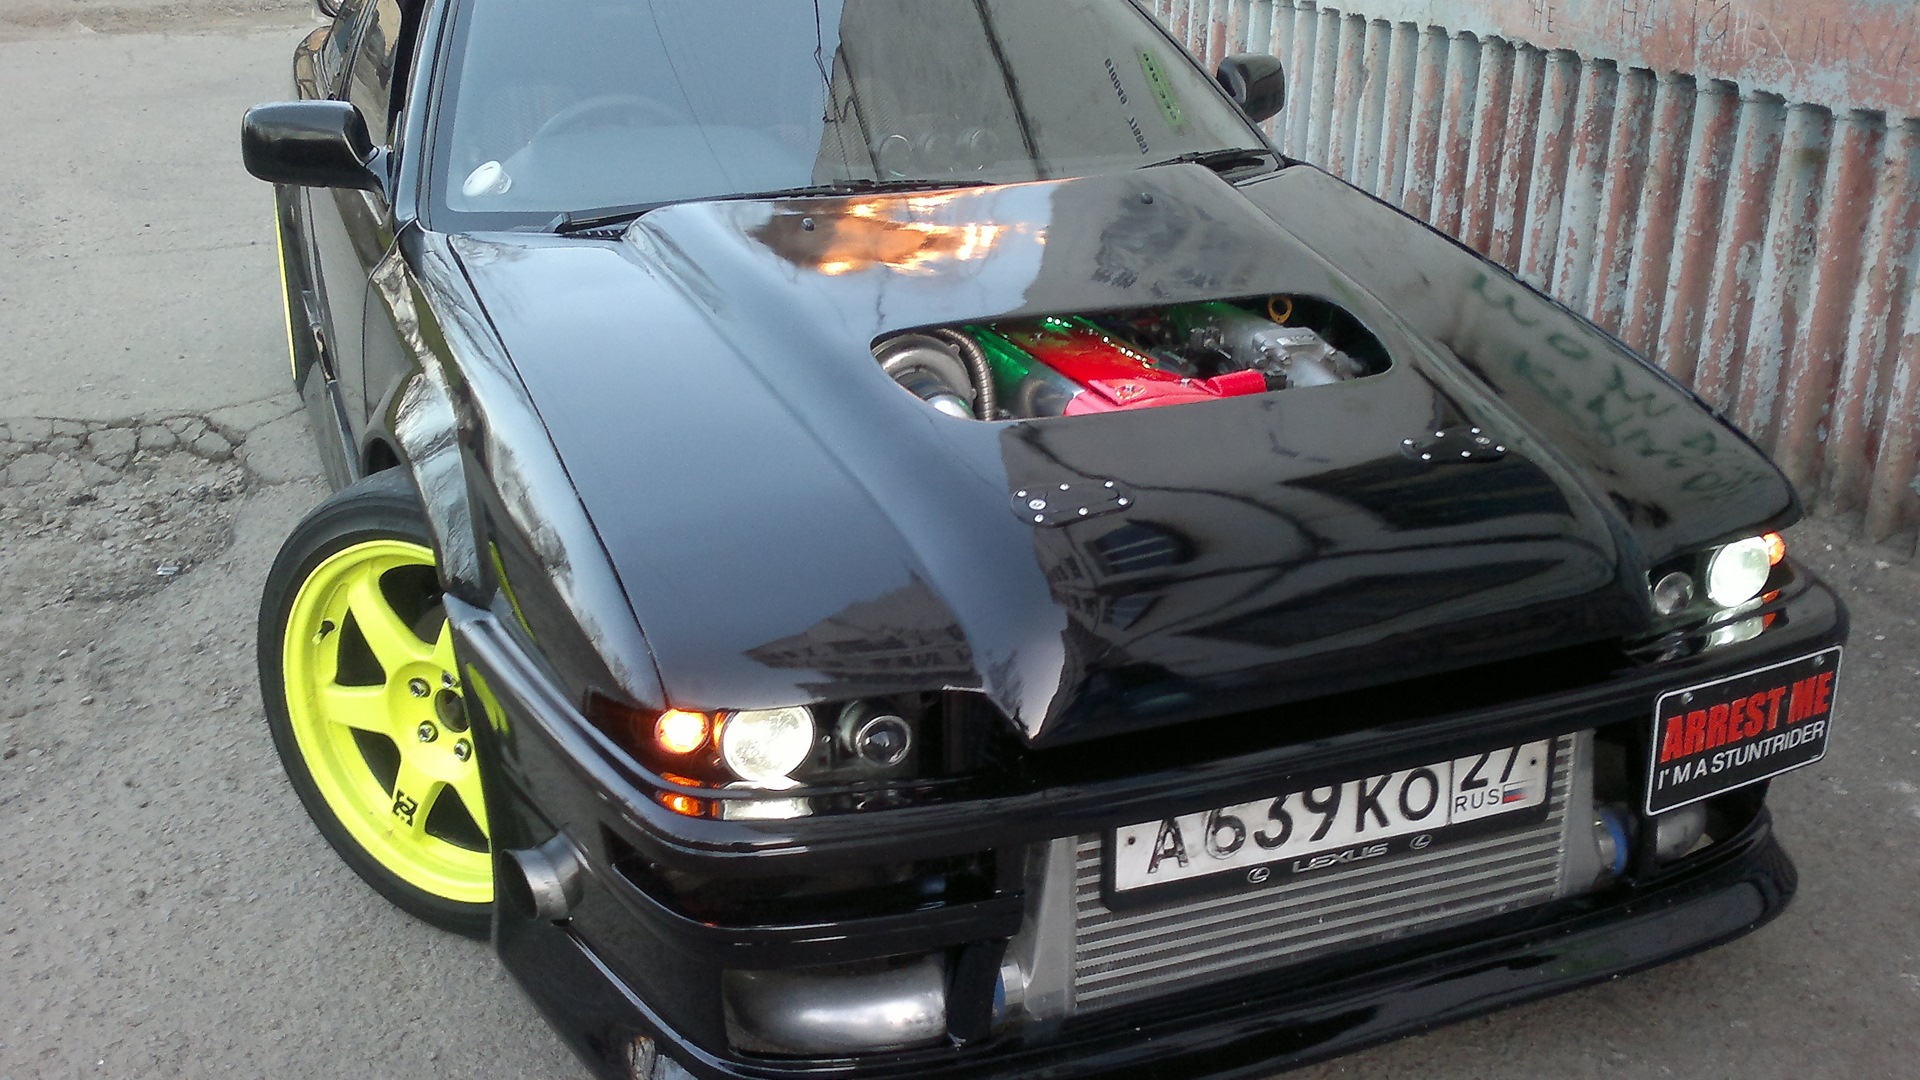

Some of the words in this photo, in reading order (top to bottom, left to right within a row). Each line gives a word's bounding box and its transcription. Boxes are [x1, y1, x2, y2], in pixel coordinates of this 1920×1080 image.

[1660, 686, 1786, 763] ARREST
[1787, 671, 1833, 724] ME
[1693, 758, 1707, 780] A
[1711, 720, 1825, 773] STUNTRIDER
[1454, 788, 1500, 814] RUS
[1292, 843, 1389, 874] LEXUS
